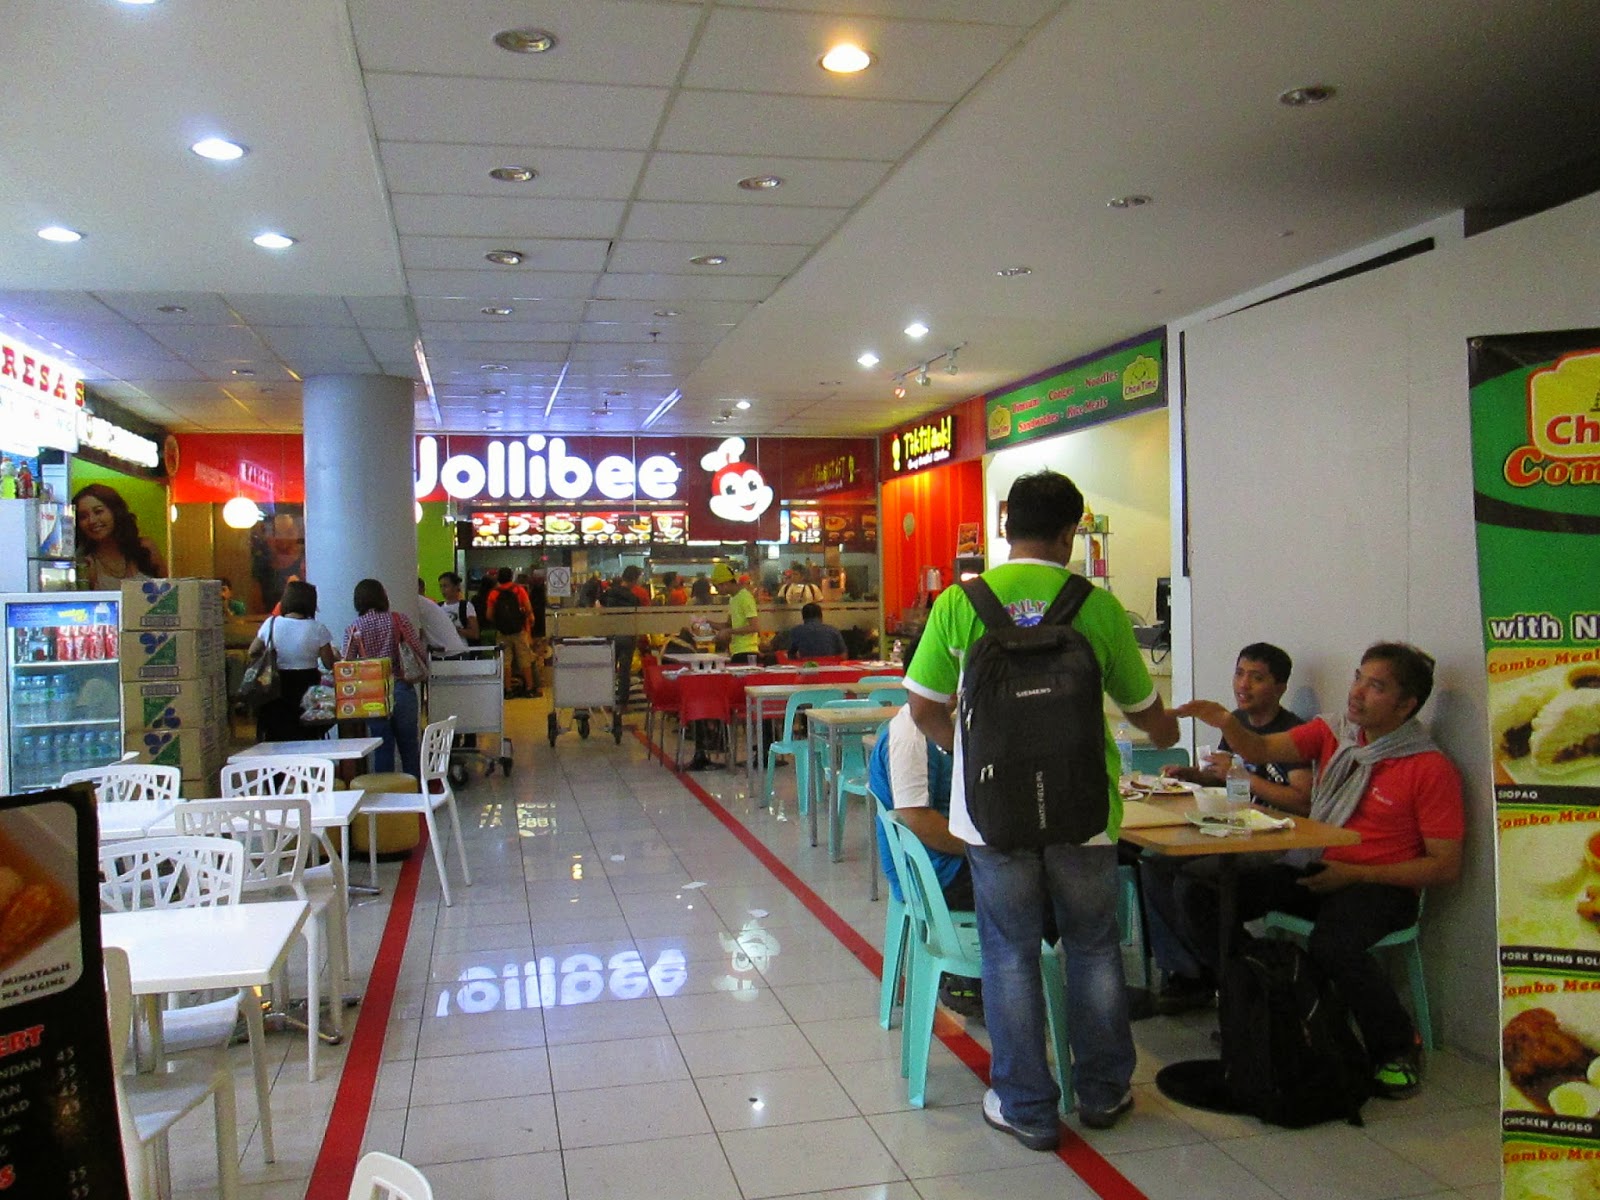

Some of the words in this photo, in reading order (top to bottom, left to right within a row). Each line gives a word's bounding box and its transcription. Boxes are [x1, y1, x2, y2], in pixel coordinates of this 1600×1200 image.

[1085, 372, 1118, 387] Noodles
[415, 434, 680, 499] Jollibee
[1490, 615, 1559, 639] with
[1488, 655, 1547, 674] Combo
[1015, 687, 1052, 698] SIEMENS
[1498, 790, 1538, 800] SIOPAO
[1502, 951, 1529, 961] PORK
[1533, 952, 1573, 964] SPRING
[1503, 1117, 1549, 1128] CHICKEN
[1552, 1120, 1593, 1132] ADOBO
